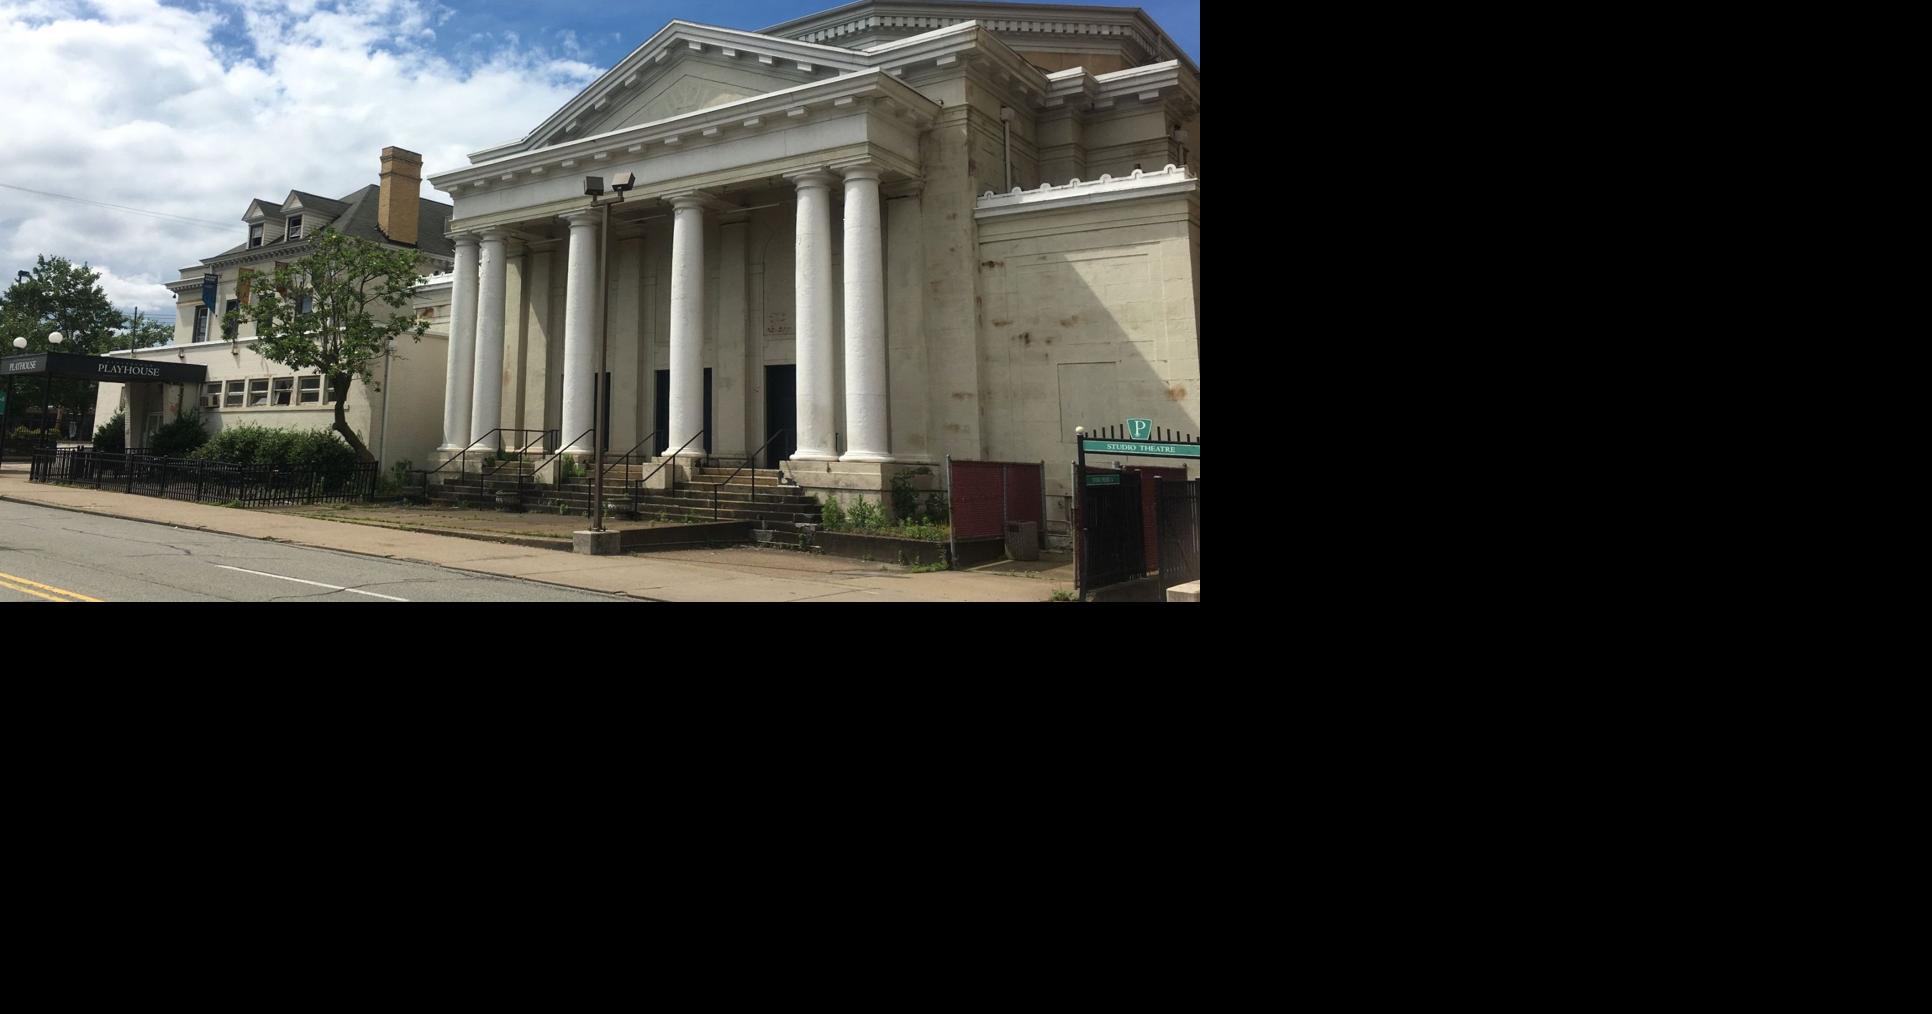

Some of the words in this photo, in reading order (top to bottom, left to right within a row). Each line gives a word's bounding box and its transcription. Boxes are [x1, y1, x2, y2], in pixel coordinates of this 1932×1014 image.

[9, 360, 38, 371] PLAYHOUSE
[98, 363, 160, 377] PLAYHOUSE
[1134, 420, 1146, 437] P
[1107, 443, 1136, 451] STUDIO
[1140, 445, 1176, 453] THEATRE
